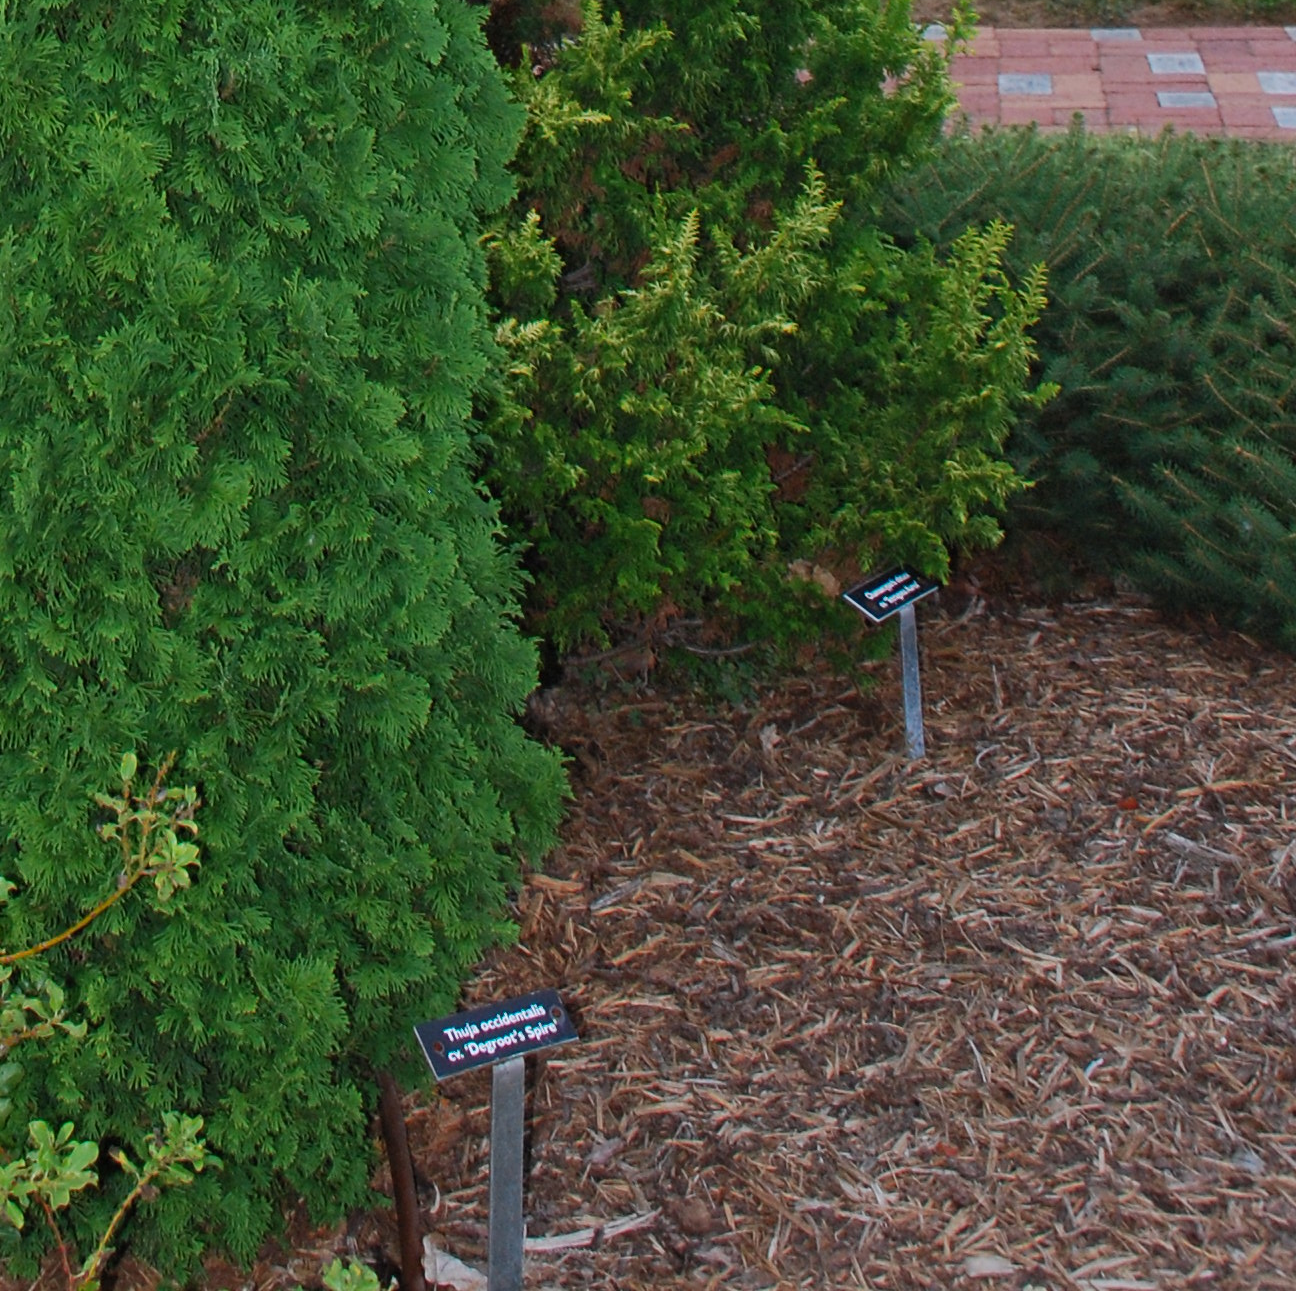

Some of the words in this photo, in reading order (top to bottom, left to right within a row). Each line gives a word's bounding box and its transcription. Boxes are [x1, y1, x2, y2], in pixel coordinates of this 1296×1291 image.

[443, 1023, 480, 1043] Thuja
[480, 1004, 546, 1032] occidentalis
[447, 1050, 465, 1062] cv.
